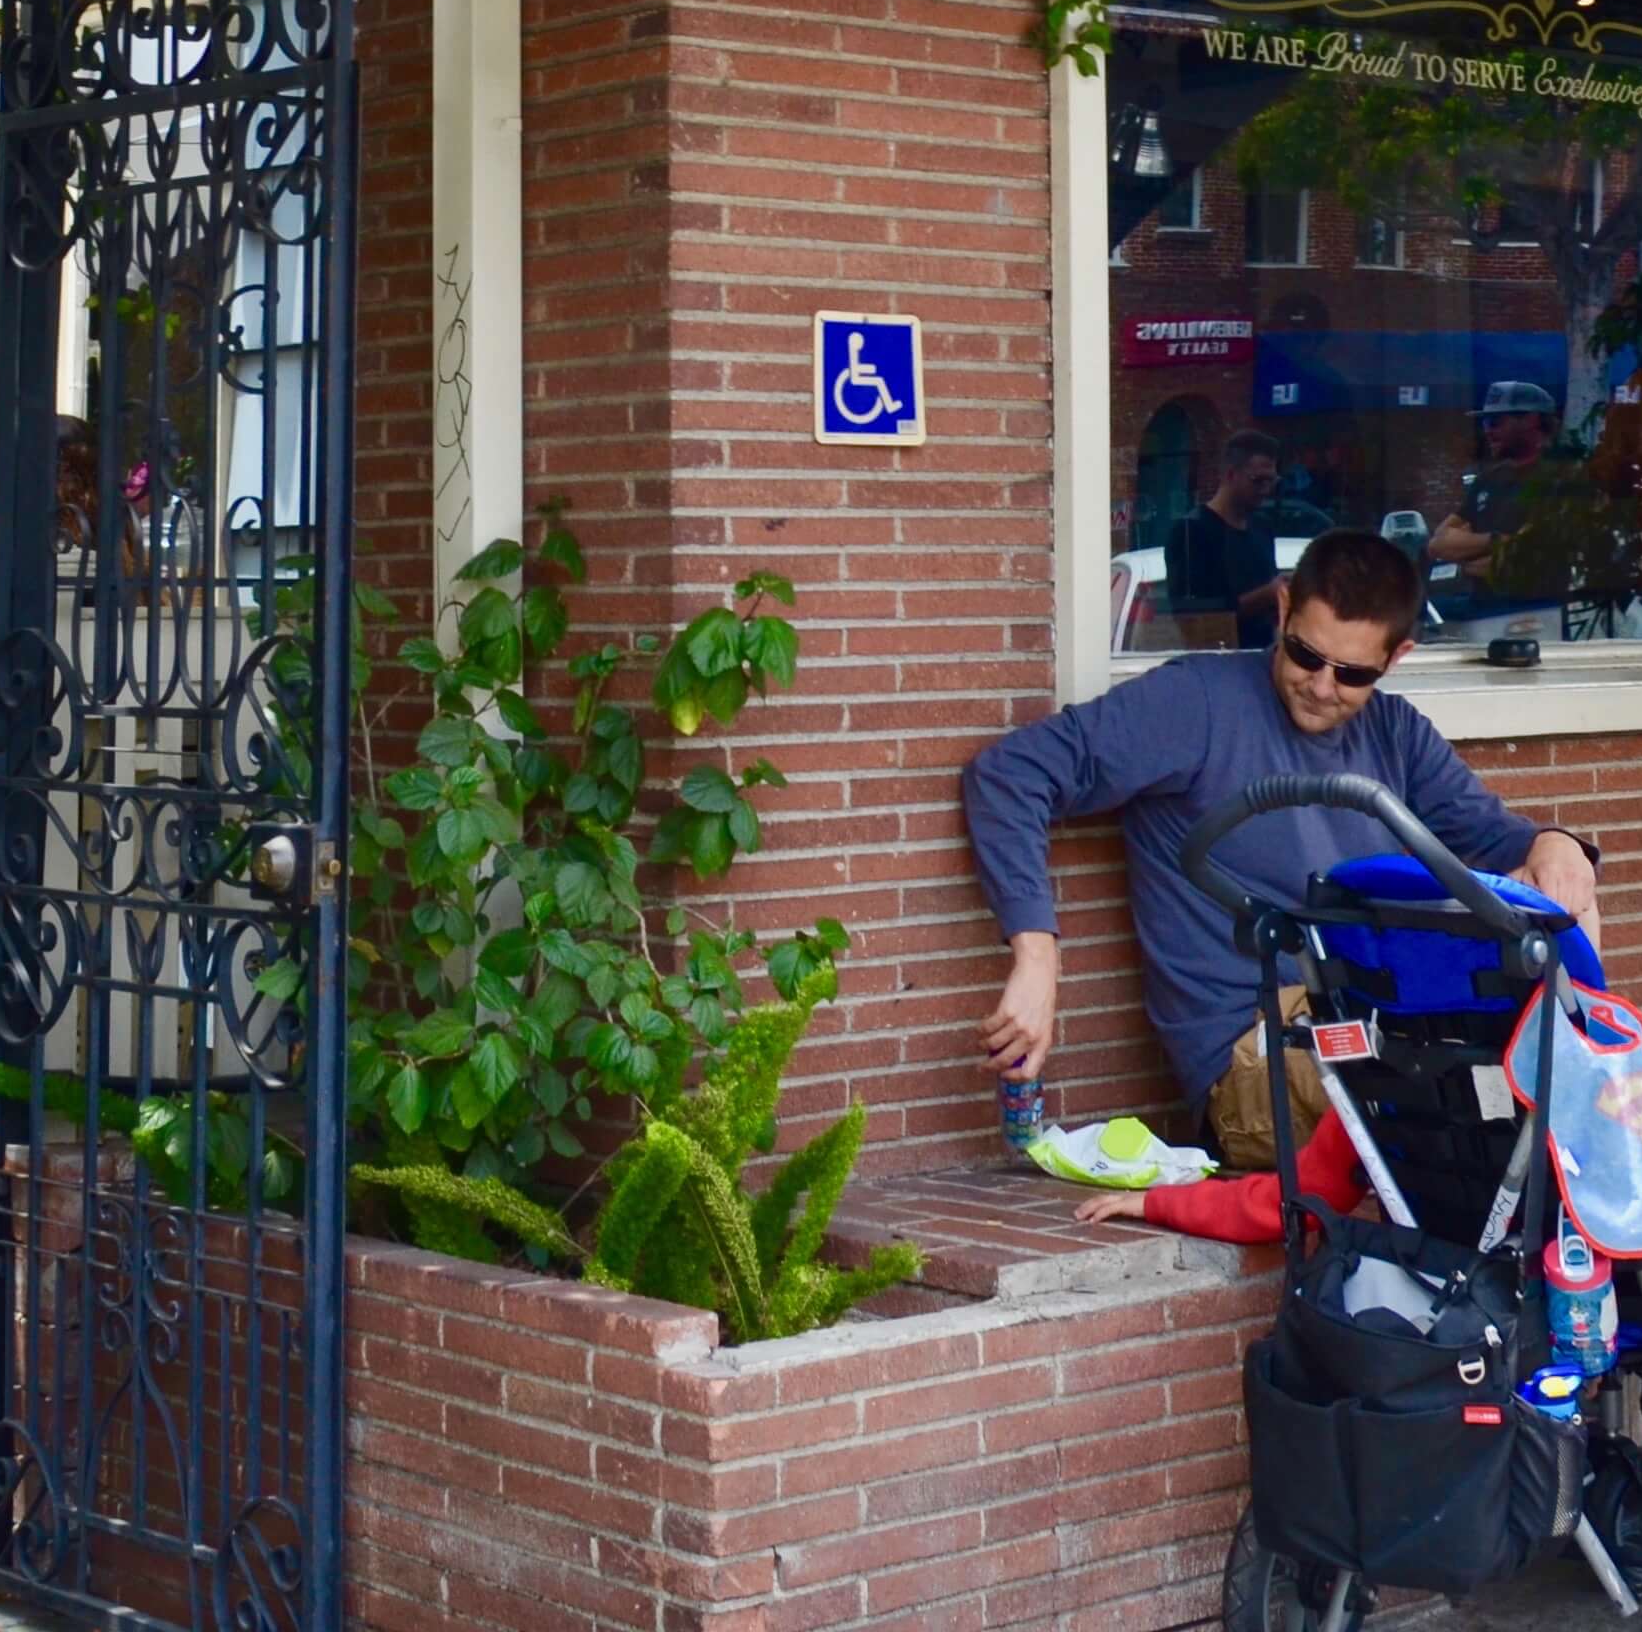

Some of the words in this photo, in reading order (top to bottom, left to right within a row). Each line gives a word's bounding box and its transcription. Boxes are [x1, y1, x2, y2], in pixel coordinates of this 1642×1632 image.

[1202, 27, 1246, 61] WE
[1252, 35, 1307, 67] ARE
[1310, 31, 1408, 79] Proud
[1410, 52, 1447, 83] TO
[1452, 55, 1526, 92] SERVE
